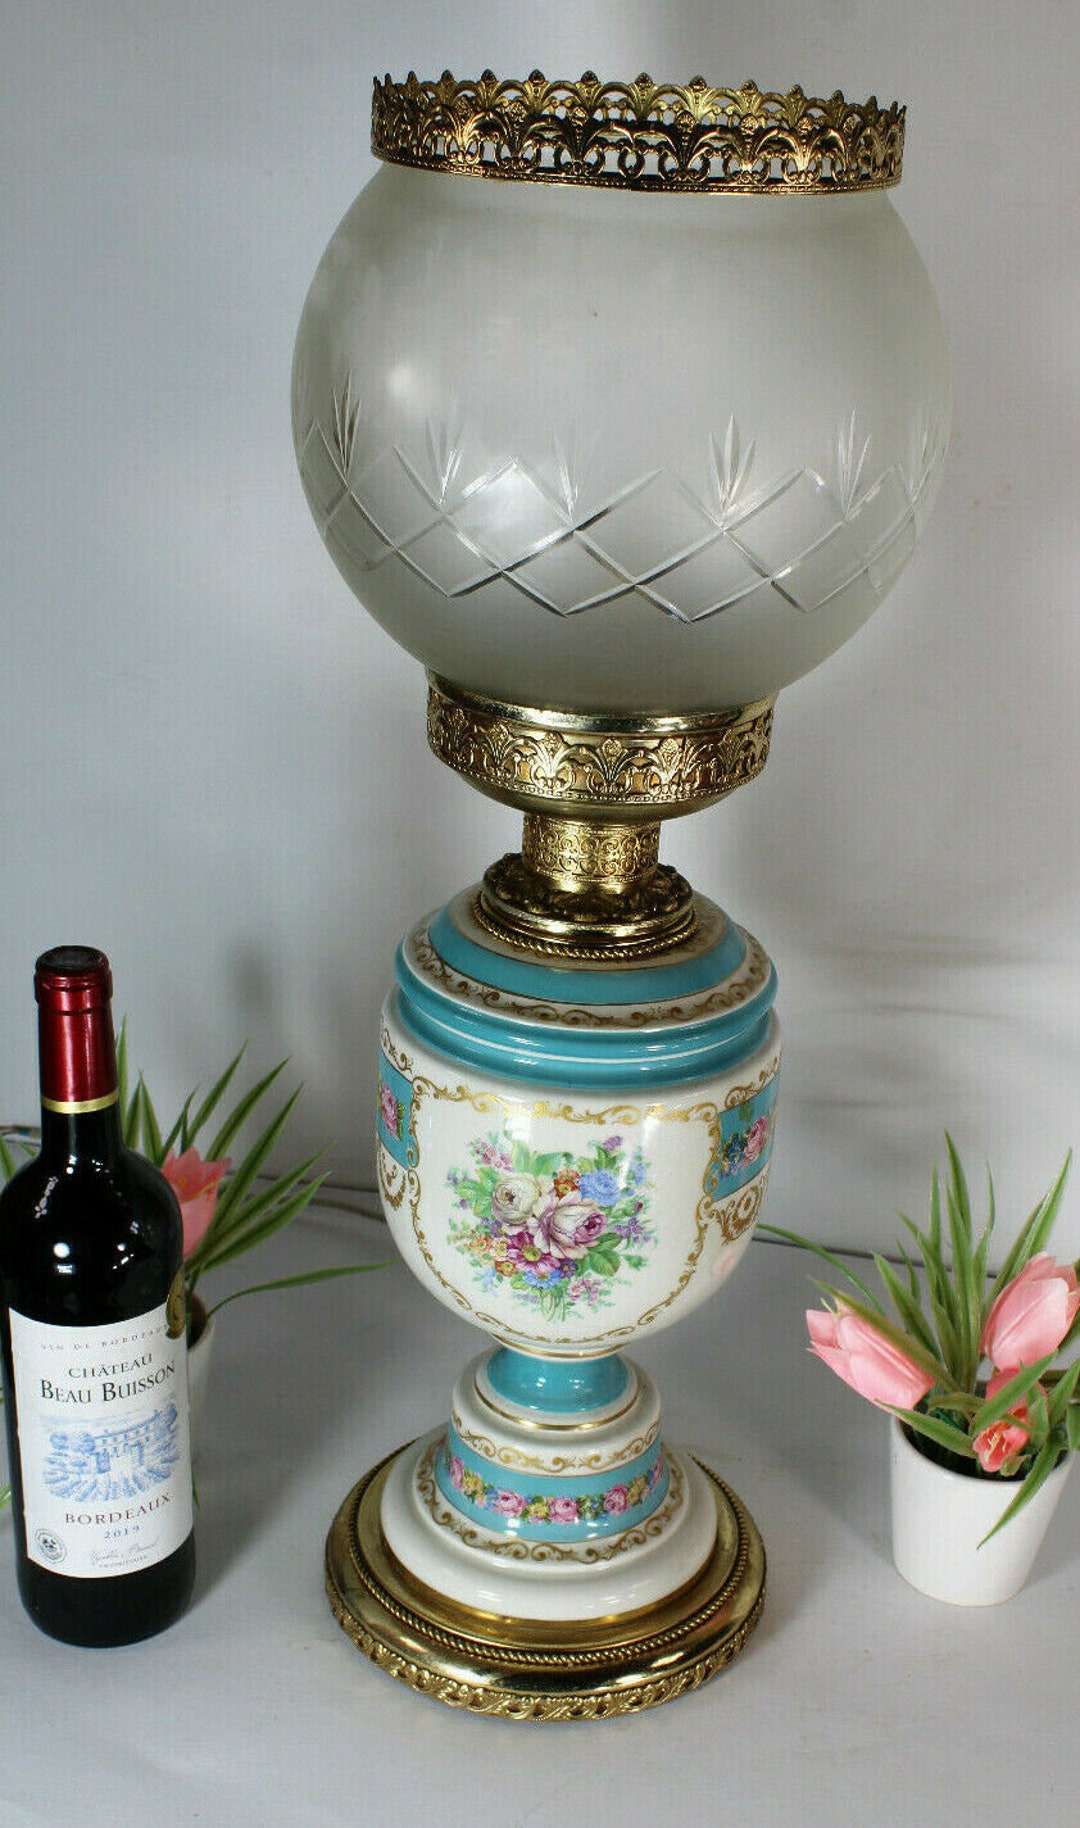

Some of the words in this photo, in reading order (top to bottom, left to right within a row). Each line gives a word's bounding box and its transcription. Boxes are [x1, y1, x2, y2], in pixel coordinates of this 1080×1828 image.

[68, 1353, 153, 1379] CHÂTEAU
[40, 1379, 92, 1404] BEAU
[102, 1360, 176, 1402] BUISSON
[65, 1492, 173, 1525] BORDEAUX
[104, 1525, 140, 1540] 2019
